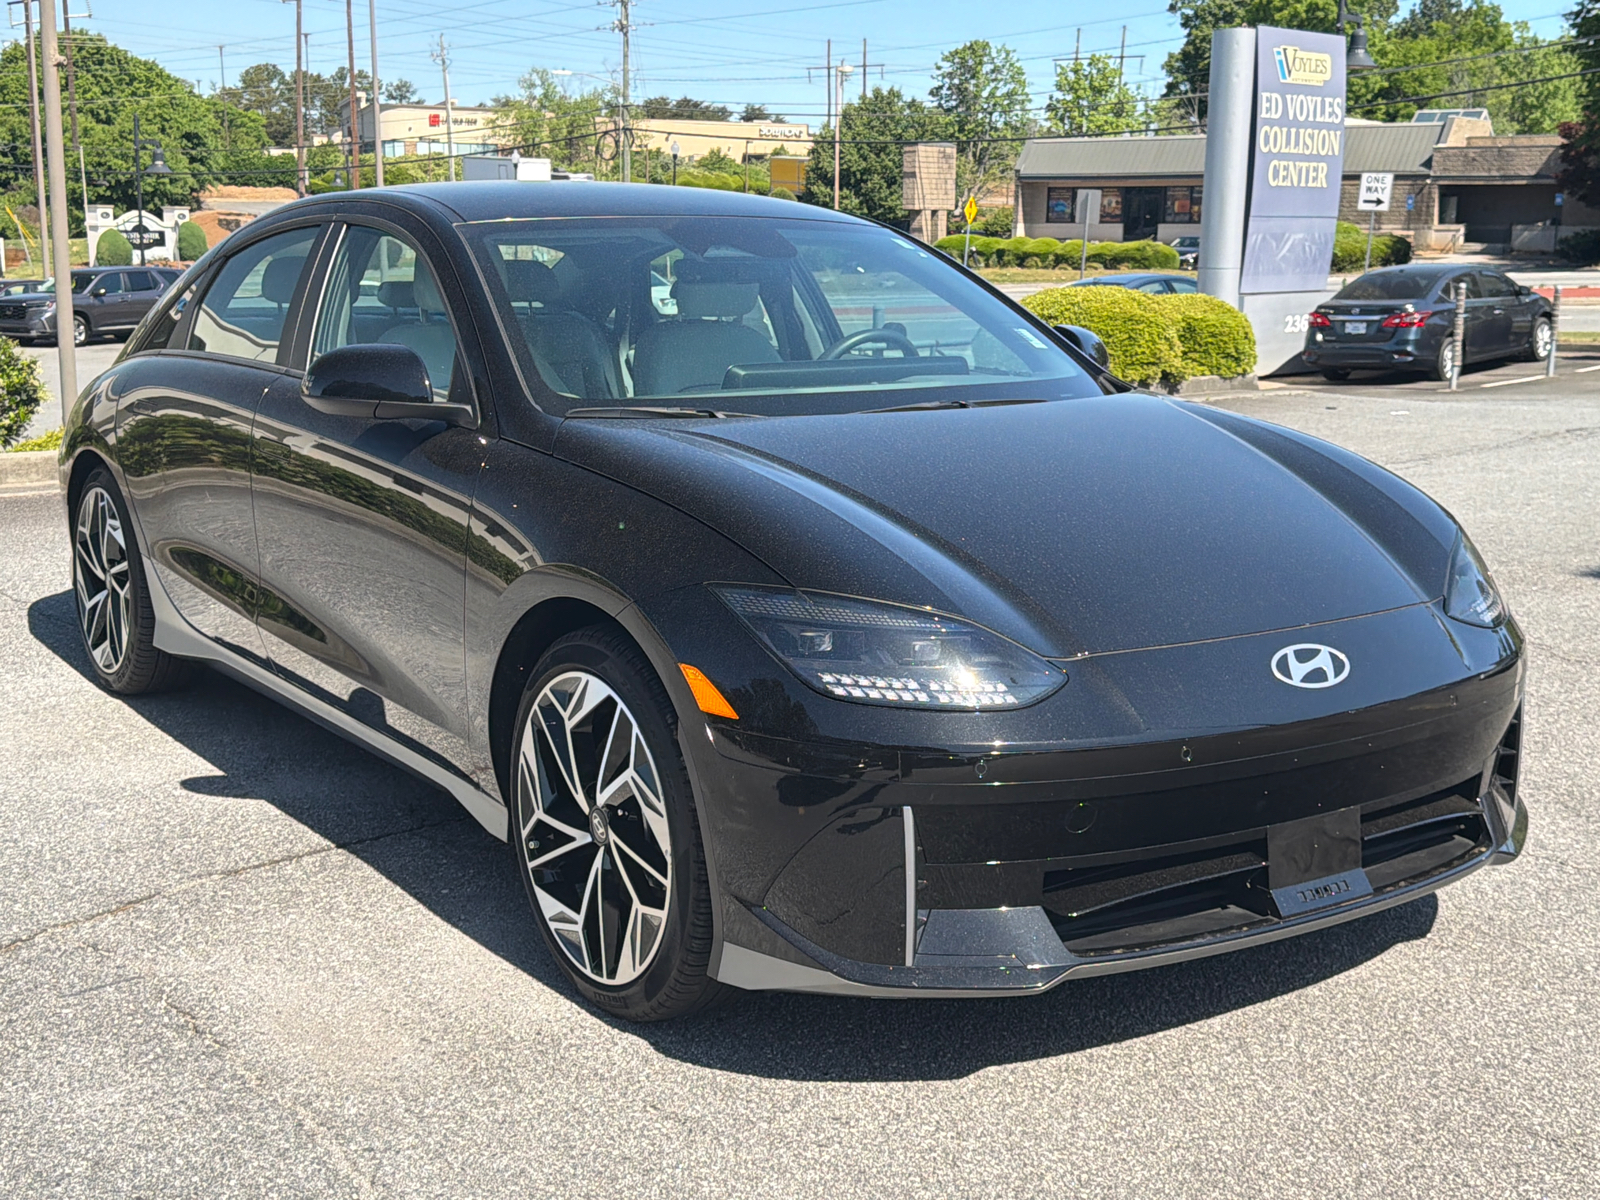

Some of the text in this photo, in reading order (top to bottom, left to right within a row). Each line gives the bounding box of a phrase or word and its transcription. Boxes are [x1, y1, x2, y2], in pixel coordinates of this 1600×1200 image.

[1260, 92, 1342, 124] ED VOYLES
[1259, 125, 1341, 156] COLLISION
[1267, 159, 1328, 188] CENTER
[1366, 175, 1388, 185] ONE
[1365, 185, 1387, 195] WAY
